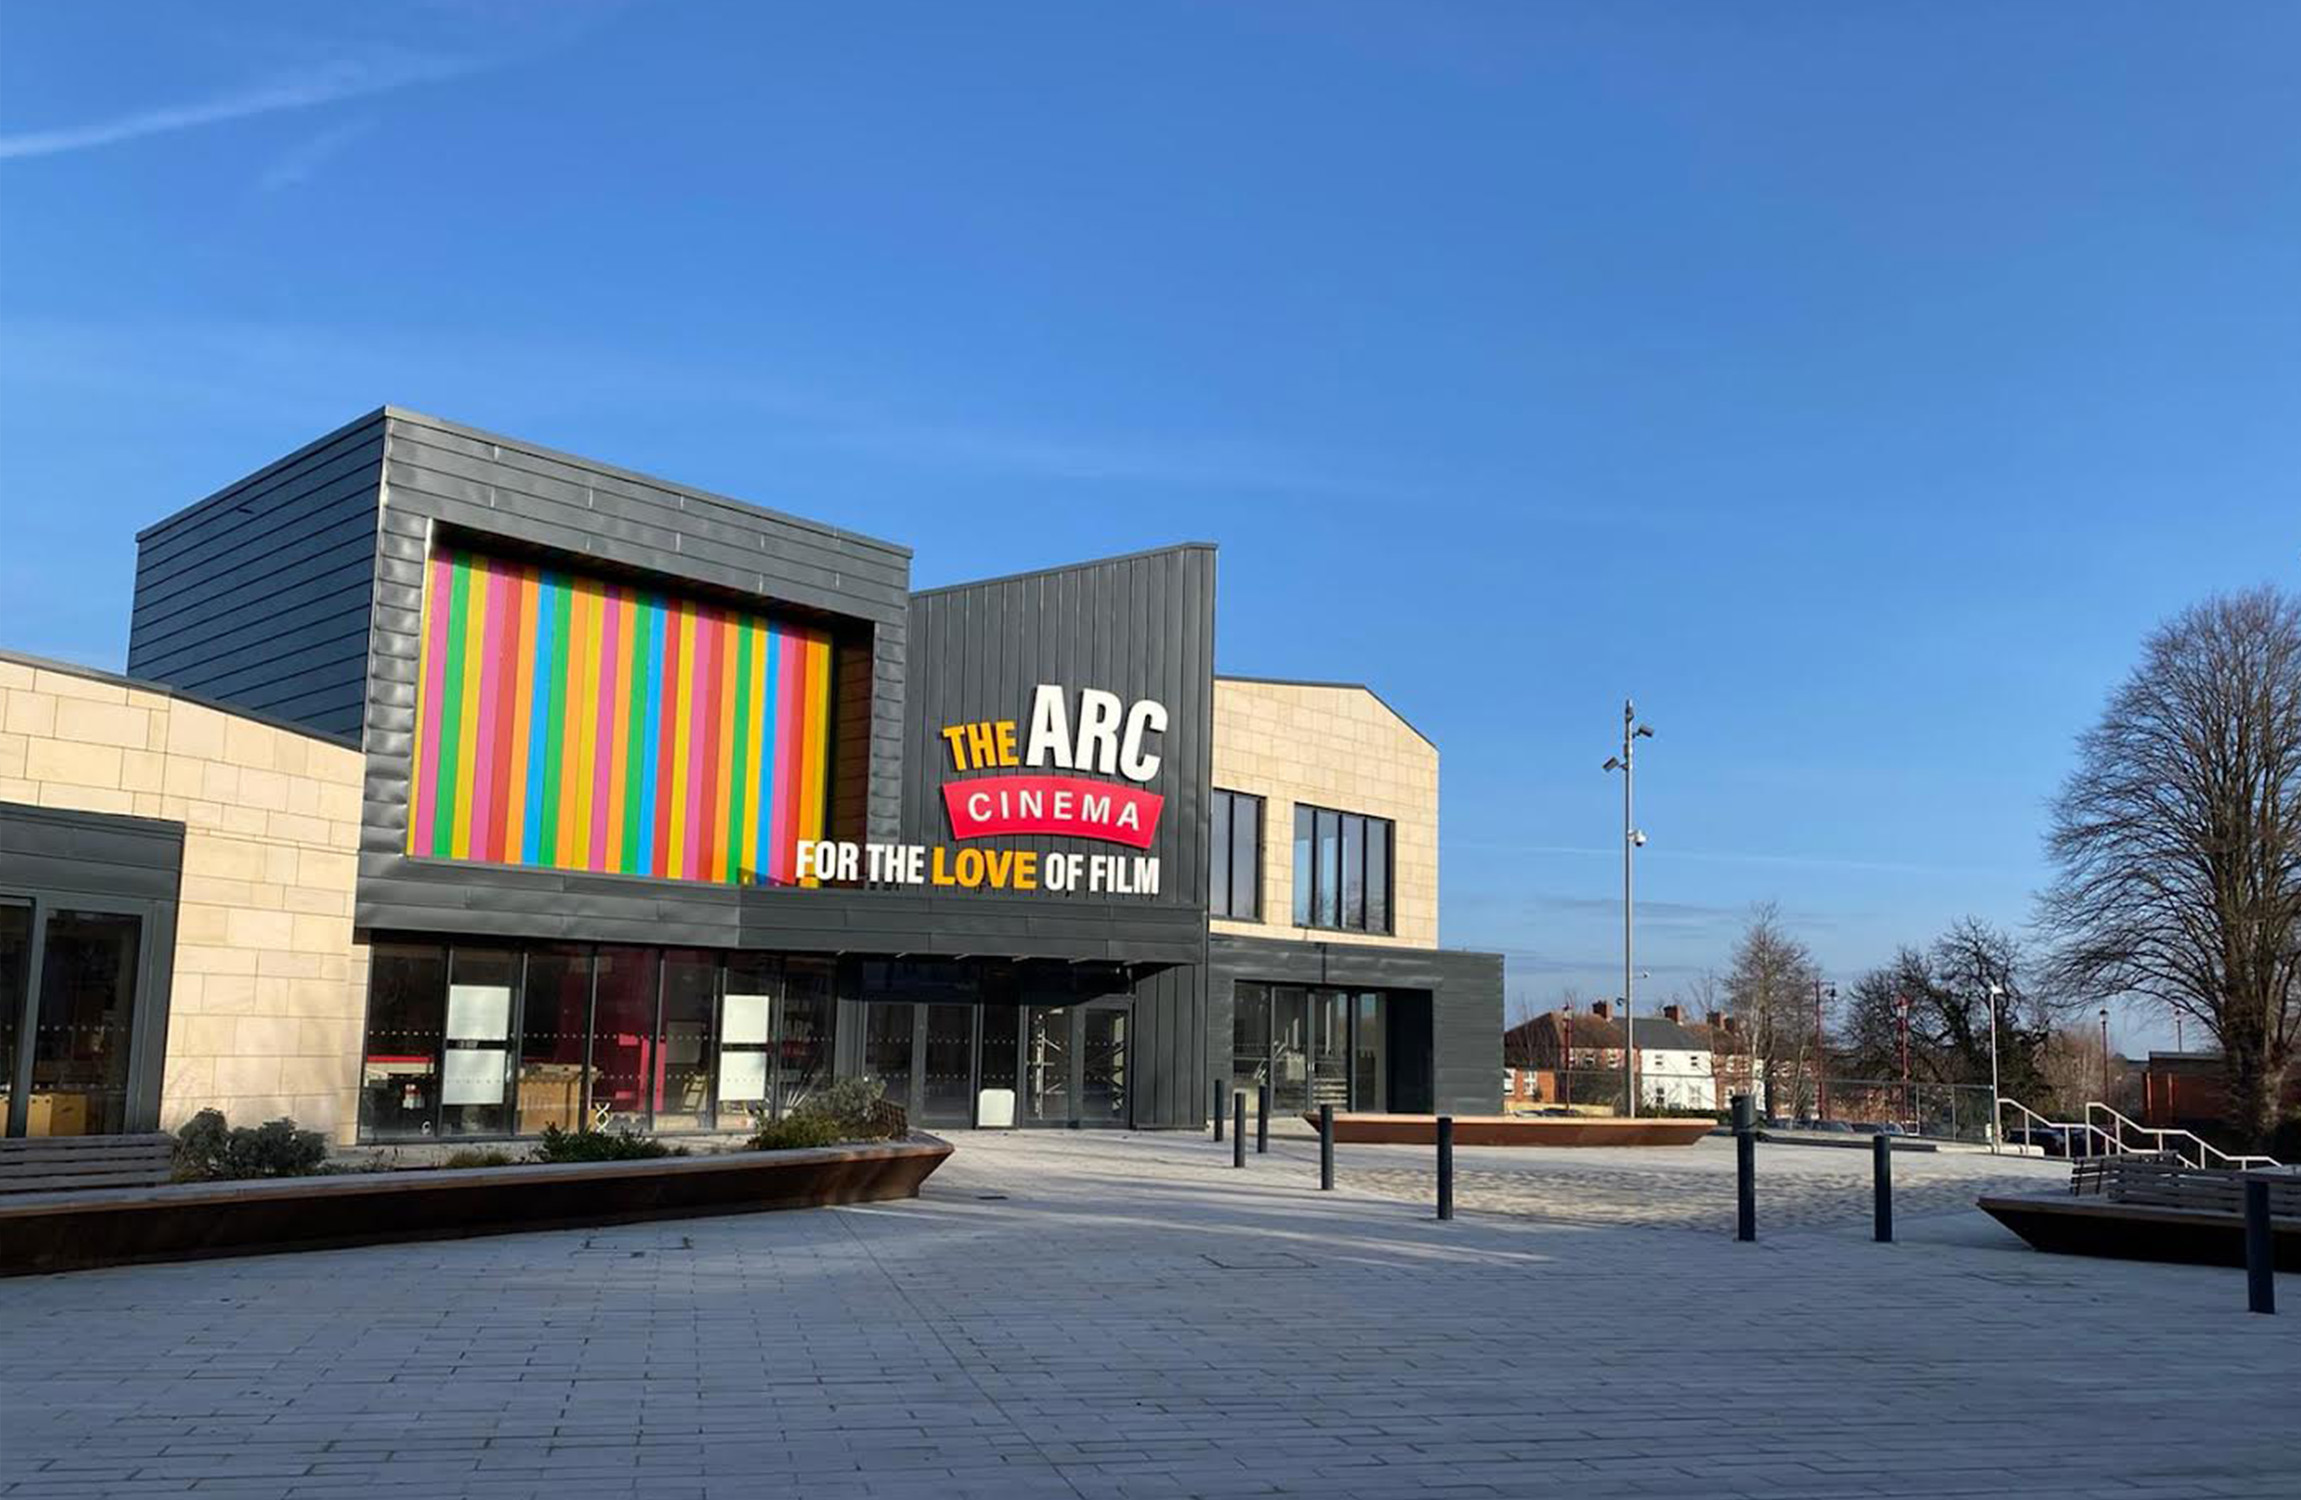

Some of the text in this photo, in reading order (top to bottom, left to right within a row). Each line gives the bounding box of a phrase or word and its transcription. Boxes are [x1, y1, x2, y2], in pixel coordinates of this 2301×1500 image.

[942, 684, 1168, 782] THE ARC
[967, 790, 1140, 831] CINEMA
[796, 840, 1160, 895] FOR THE LOVE OF FILM
